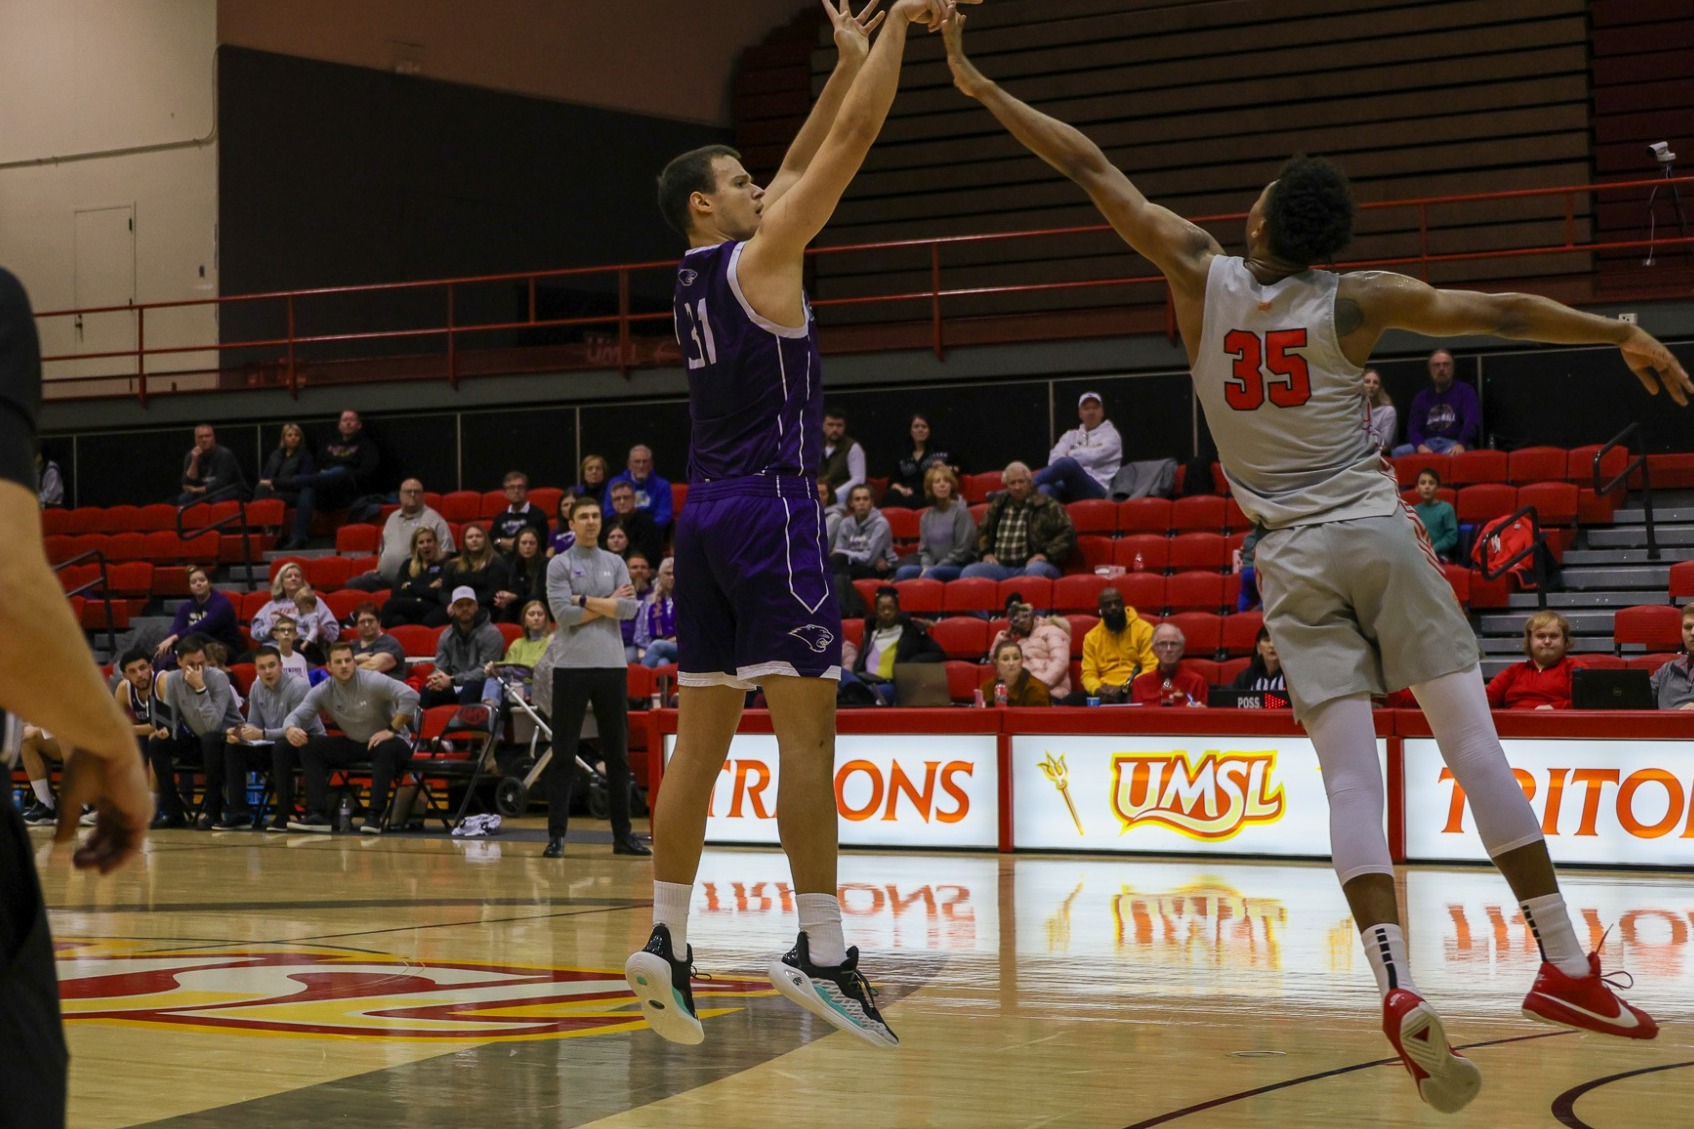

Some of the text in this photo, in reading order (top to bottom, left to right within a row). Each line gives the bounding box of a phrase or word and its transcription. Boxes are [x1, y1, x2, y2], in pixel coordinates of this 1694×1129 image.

[684, 298, 717, 370] 31
[1224, 328, 1311, 411] 35
[707, 758, 975, 824] RONS
[1110, 751, 1286, 842] UMSL
[1438, 767, 1694, 839] TITO
